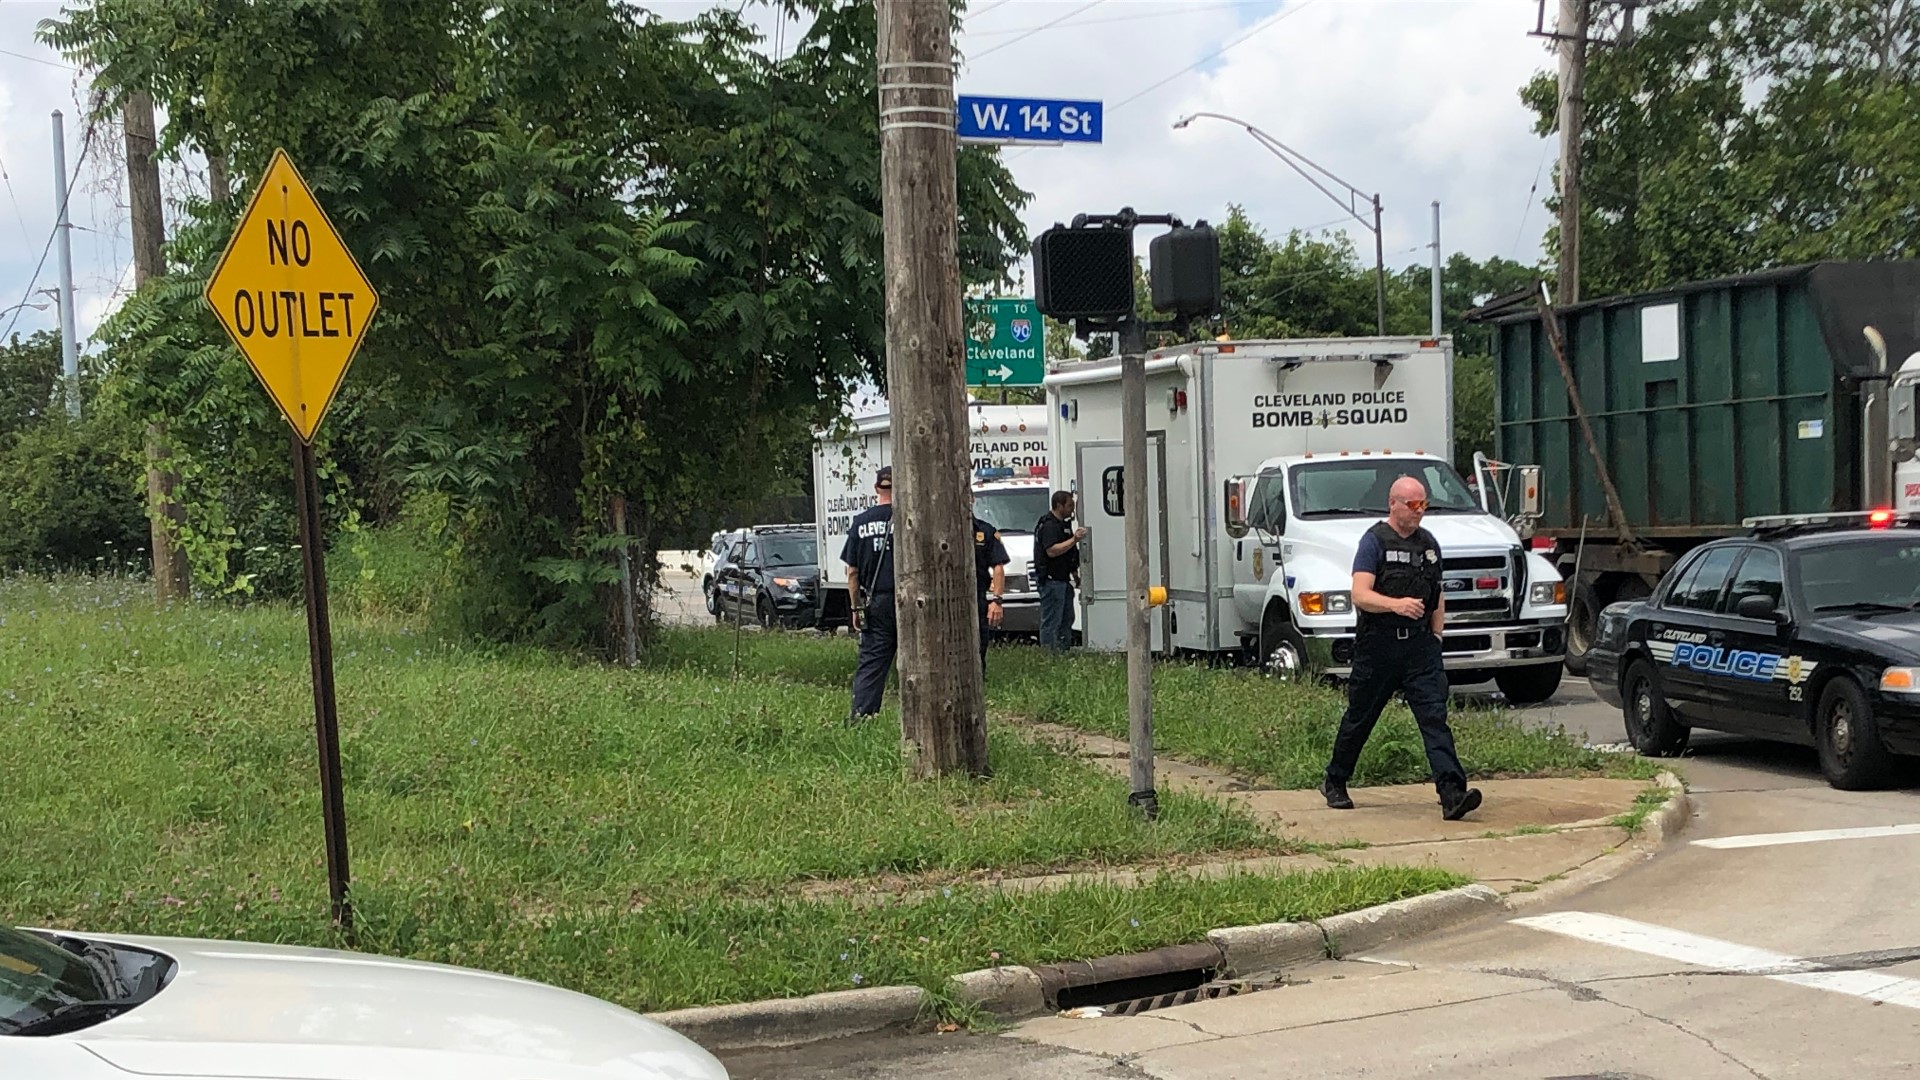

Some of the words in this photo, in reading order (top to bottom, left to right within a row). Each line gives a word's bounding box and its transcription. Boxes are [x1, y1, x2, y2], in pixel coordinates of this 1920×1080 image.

[972, 102, 1010, 131] W.
[1019, 105, 1051, 132] 14
[1059, 106, 1092, 135] St
[266, 219, 311, 267] NO
[234, 289, 354, 338] OUTLET
[1014, 303, 1028, 314] TO
[1013, 324, 1030, 338] 90
[966, 346, 1035, 359] Cleveland
[1254, 393, 1346, 407] CLEVELAND
[1352, 391, 1405, 405] POLICE
[1252, 411, 1313, 428] BOMB
[1336, 408, 1408, 425] SQUAD
[828, 496, 858, 512] CLEVELAND
[1662, 629, 1707, 644] CLEVELAND
[1671, 642, 1782, 681] POLICE
